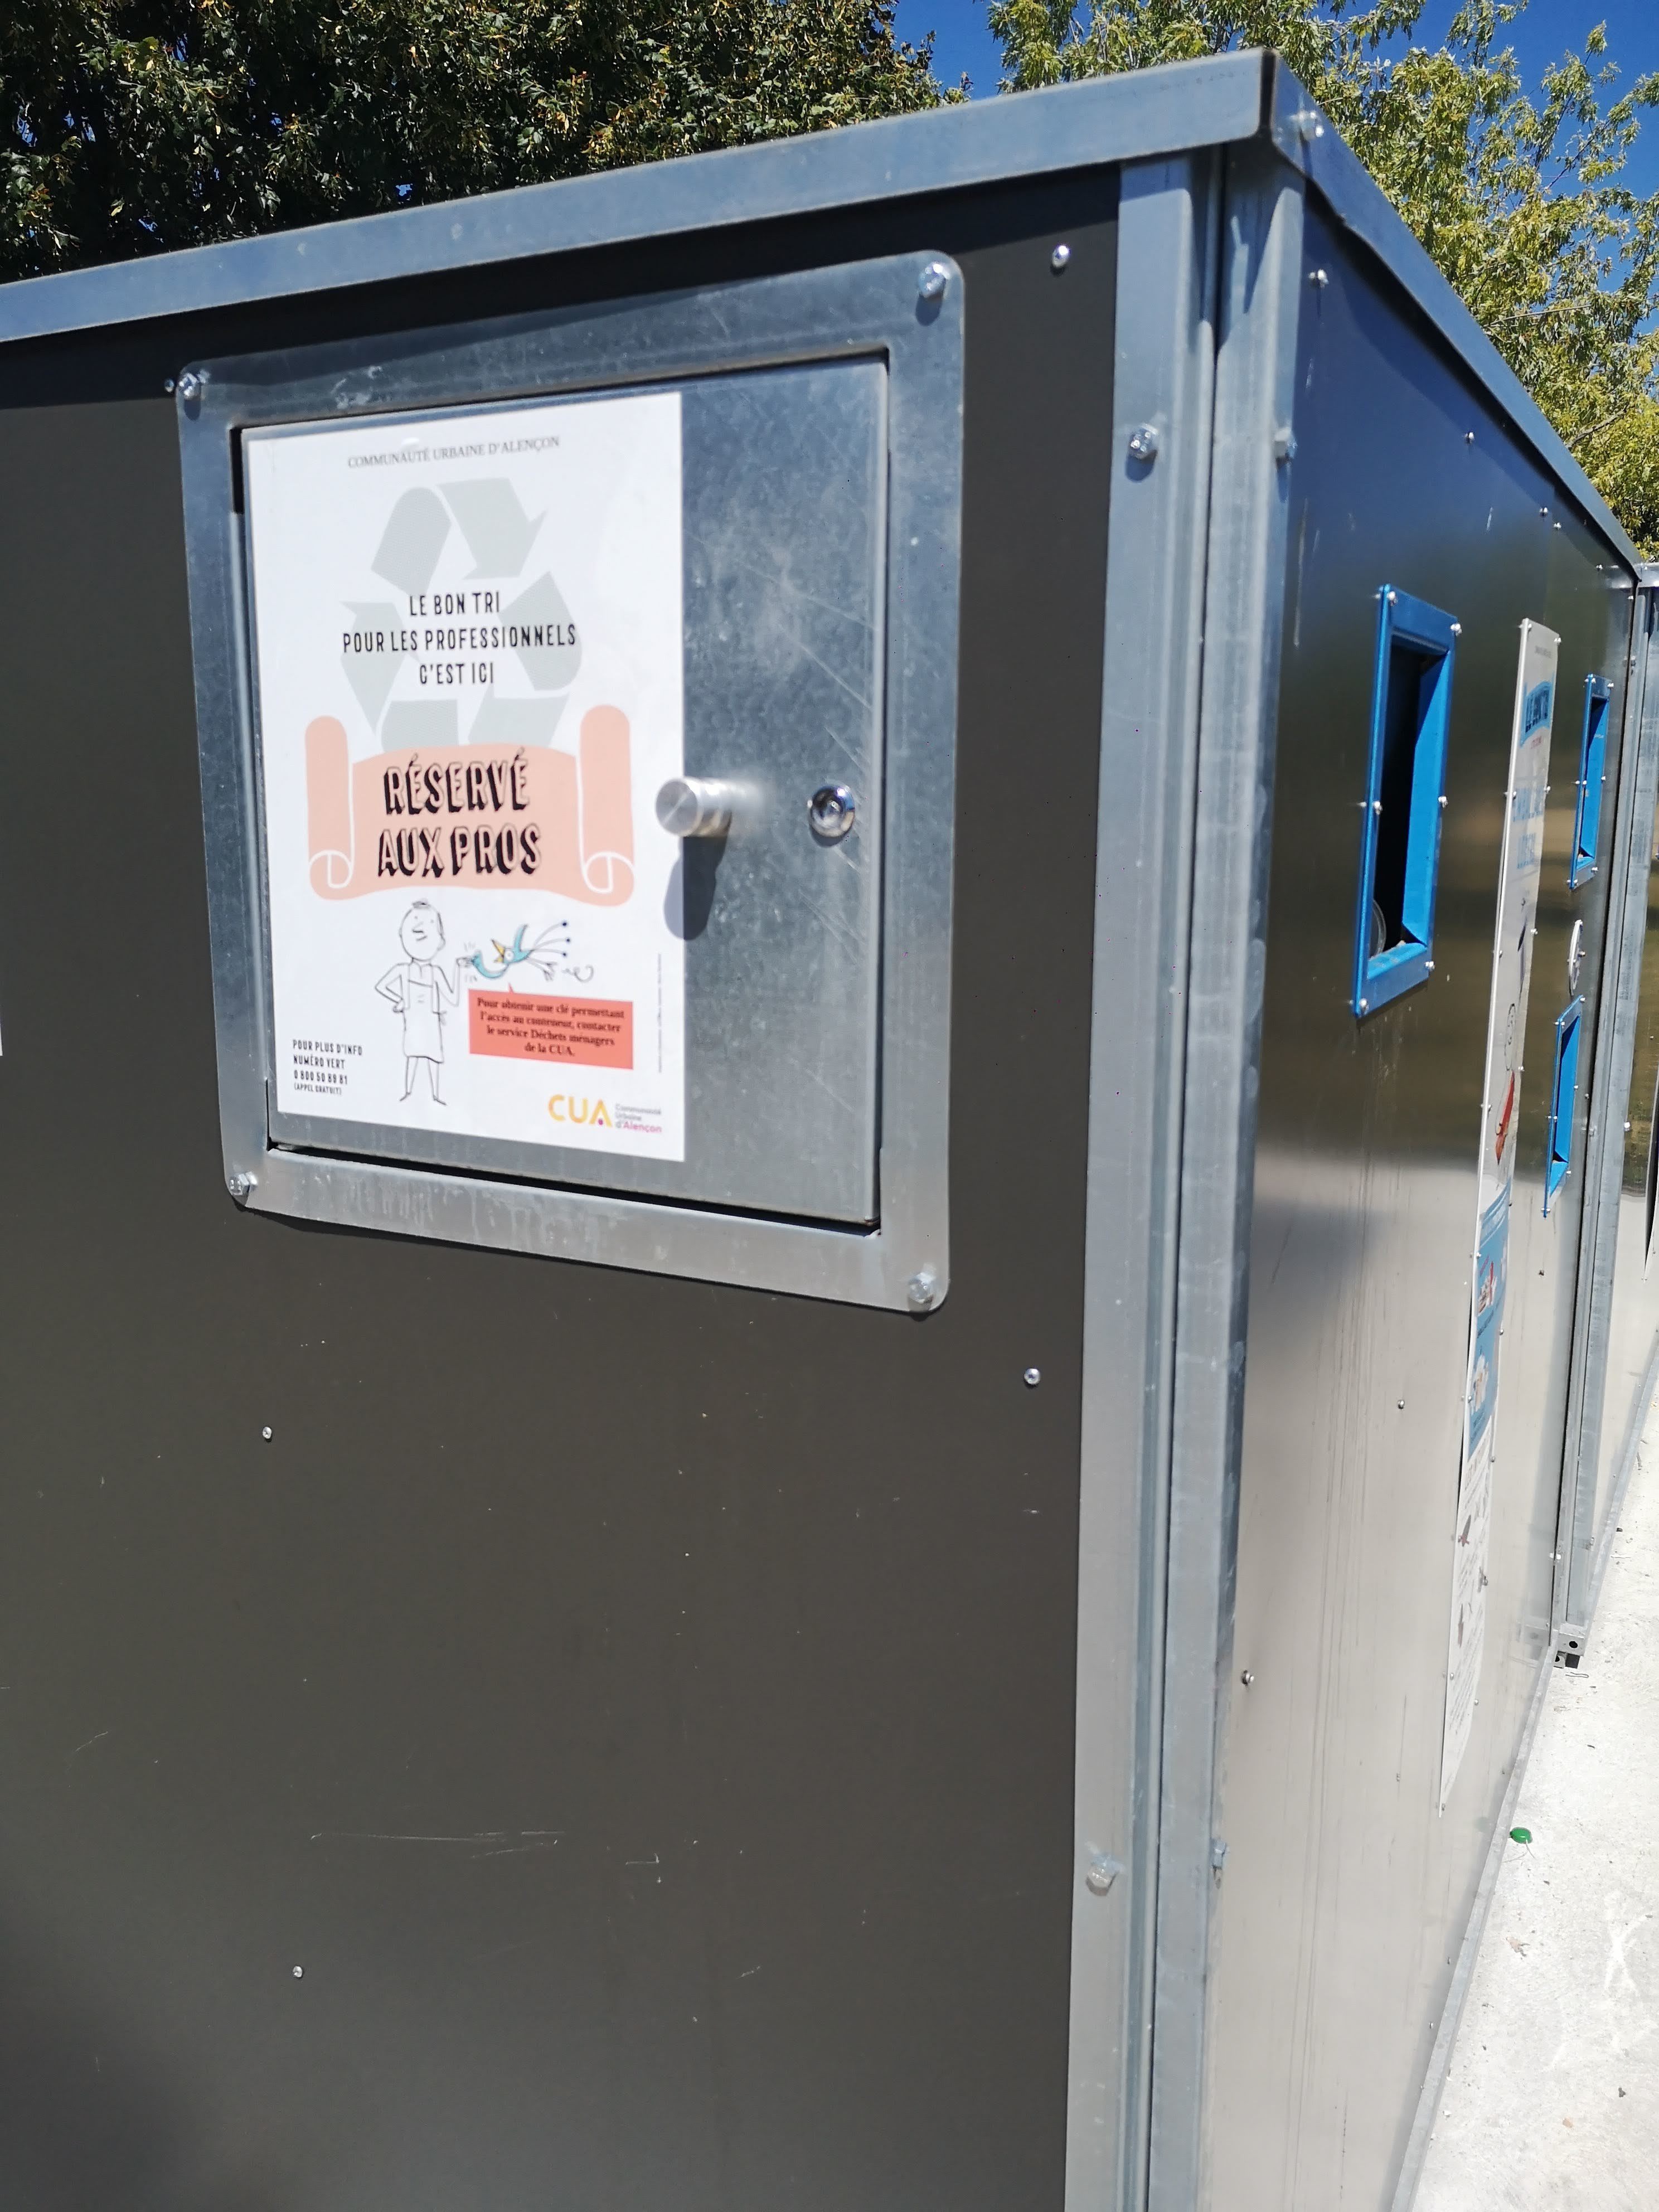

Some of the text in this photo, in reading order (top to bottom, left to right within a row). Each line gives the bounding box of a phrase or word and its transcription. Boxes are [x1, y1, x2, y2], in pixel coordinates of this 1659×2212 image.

[348, 435, 560, 468] COMMUNAUTÉ URBAINE D'ALENÇON
[409, 591, 500, 616] LE BON TRI
[343, 623, 576, 653] POUR LES PROFESSIONNELS
[419, 662, 494, 685] C'EST ICI
[383, 746, 530, 815] RÉSERVÉ
[377, 822, 541, 879] AUX PROS
[477, 997, 498, 1008] Pour
[502, 998, 533, 1011] obtenir
[571, 1007, 624, 1018] permettant
[487, 1025, 494, 1034] le
[497, 1027, 528, 1036] service
[513, 1016, 525, 1024] au
[577, 1022, 620, 1032] contacter
[293, 1039, 313, 1051] POUR
[315, 1041, 334, 1053] PLUS
[525, 1042, 536, 1051] de
[537, 1042, 547, 1053] la
[293, 1055, 345, 1069] NUMÉRO VERT
[547, 1094, 613, 1128] CUA
